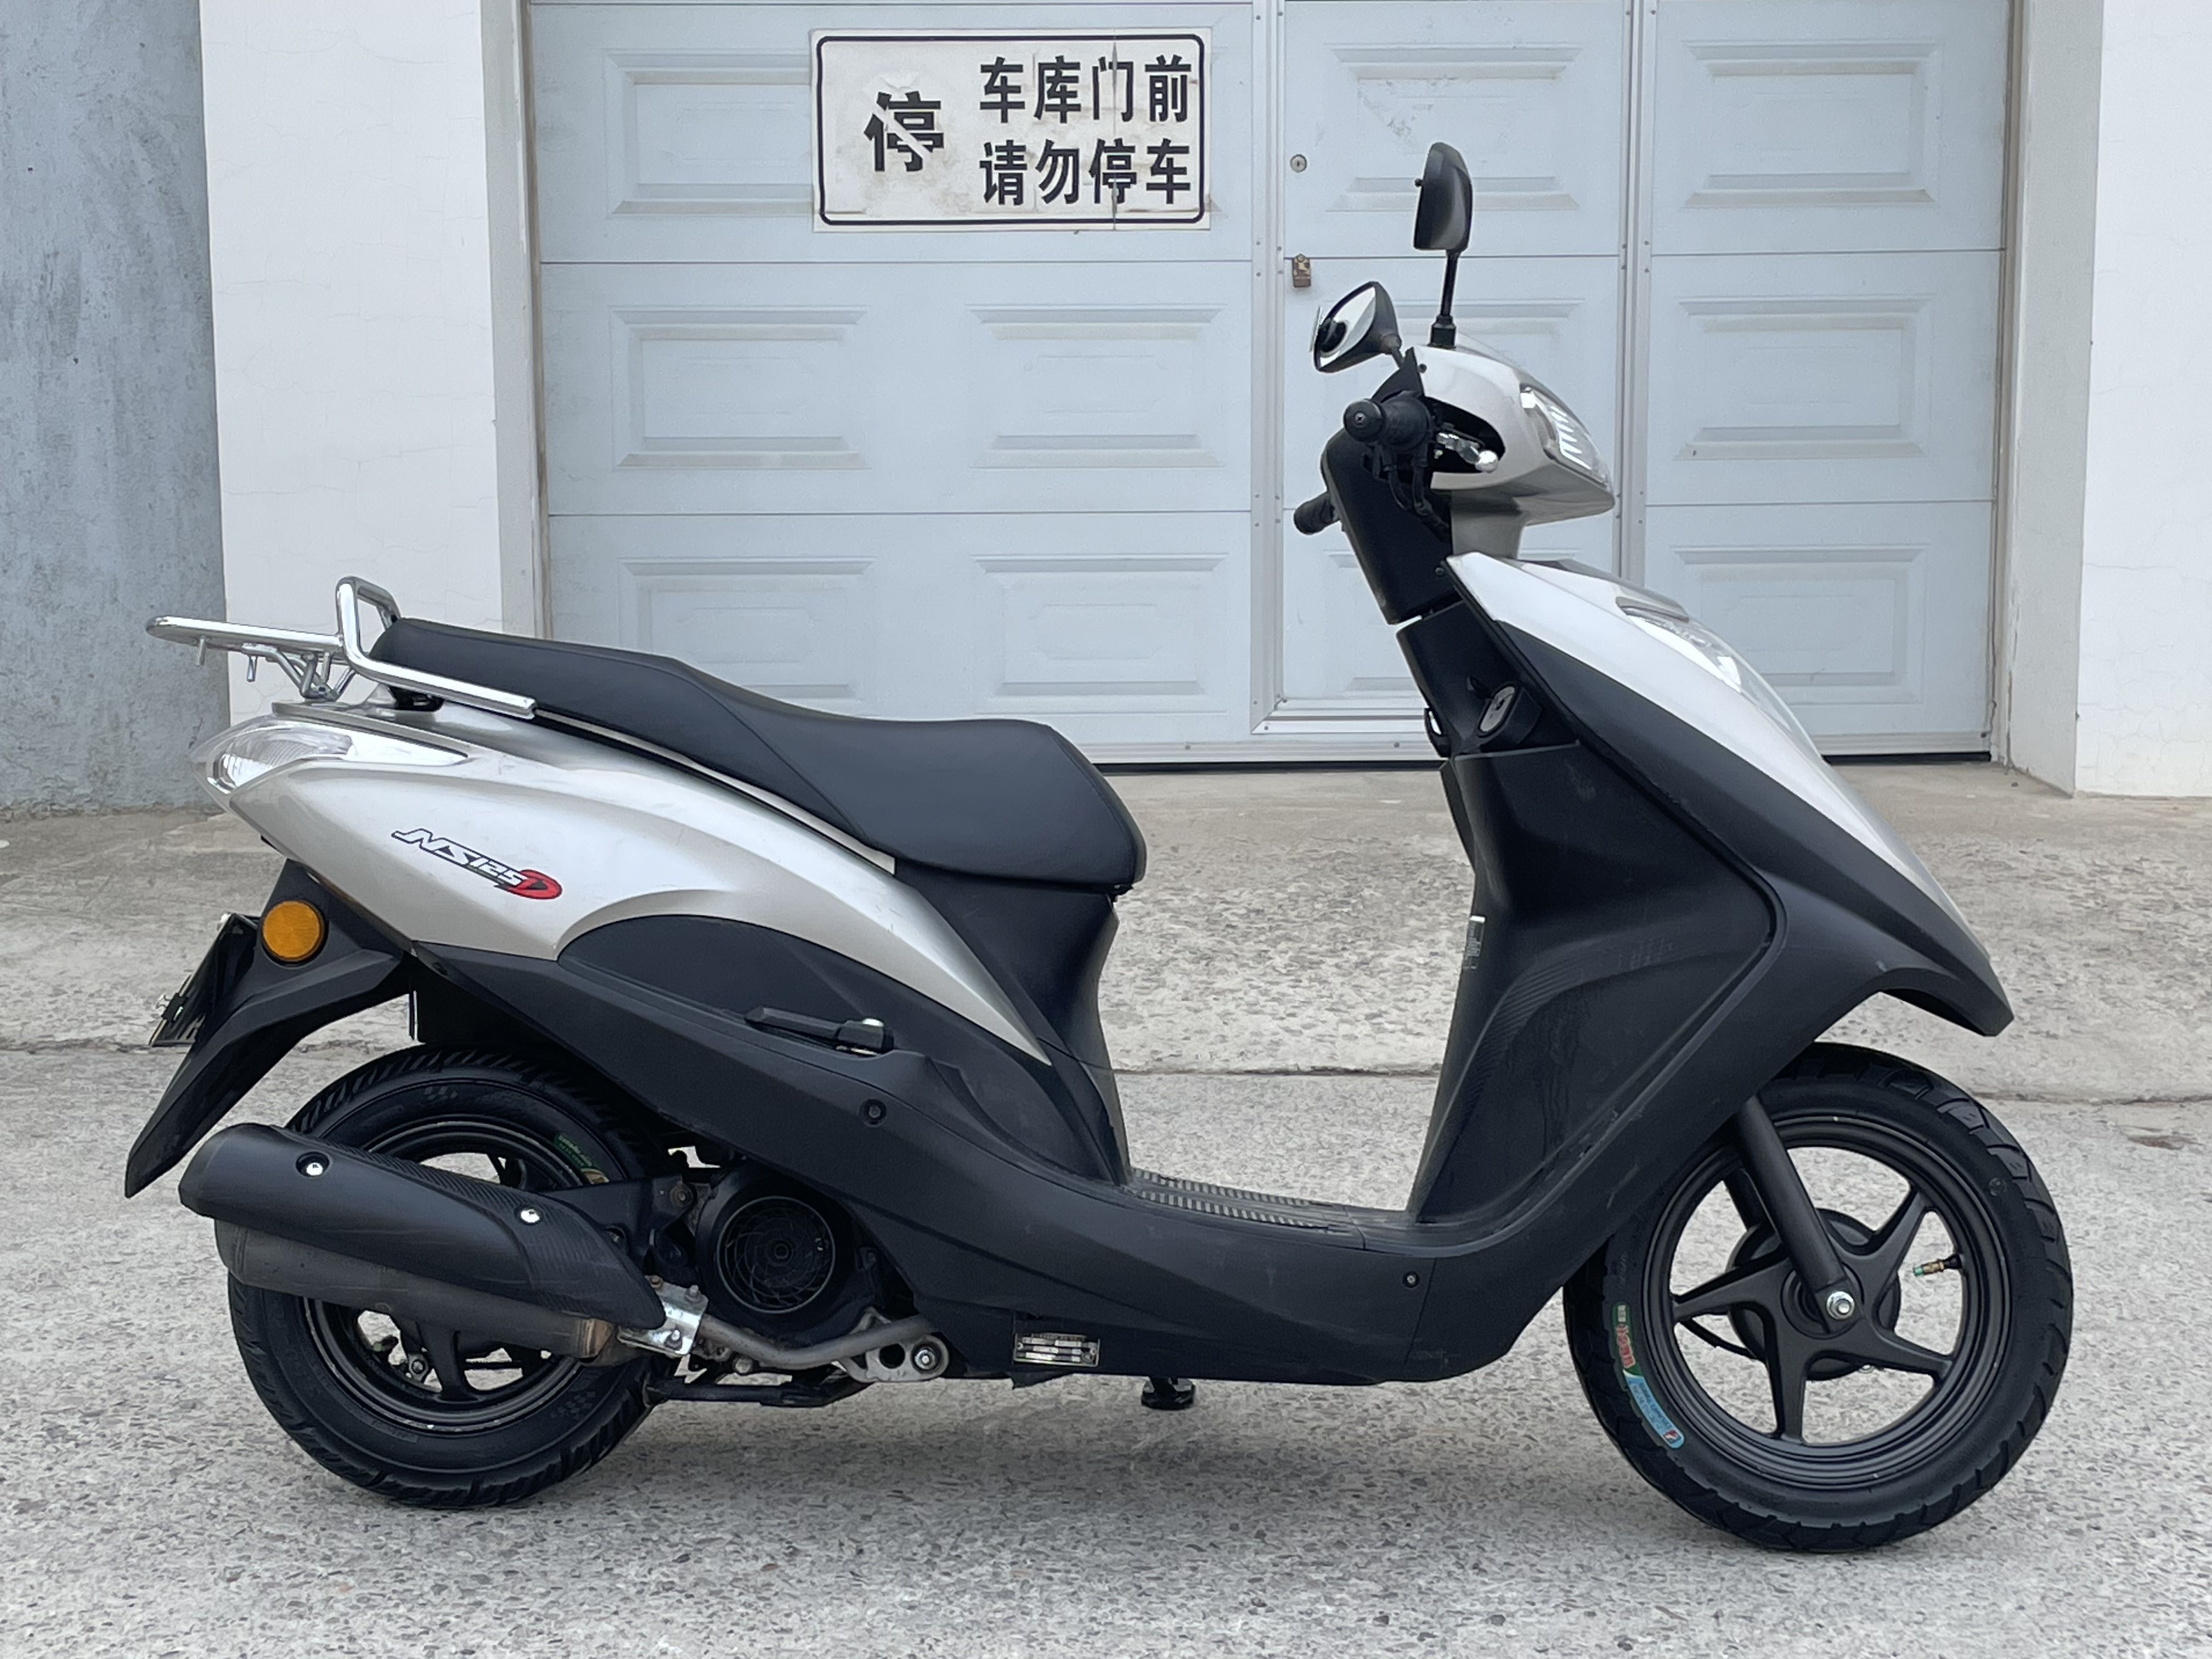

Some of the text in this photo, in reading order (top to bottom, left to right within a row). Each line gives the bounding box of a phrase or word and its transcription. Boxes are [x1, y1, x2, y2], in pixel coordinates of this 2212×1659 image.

[980, 55, 1192, 123] 车库门前
[864, 91, 944, 172] 停
[980, 138, 1192, 206] 请勿停车
